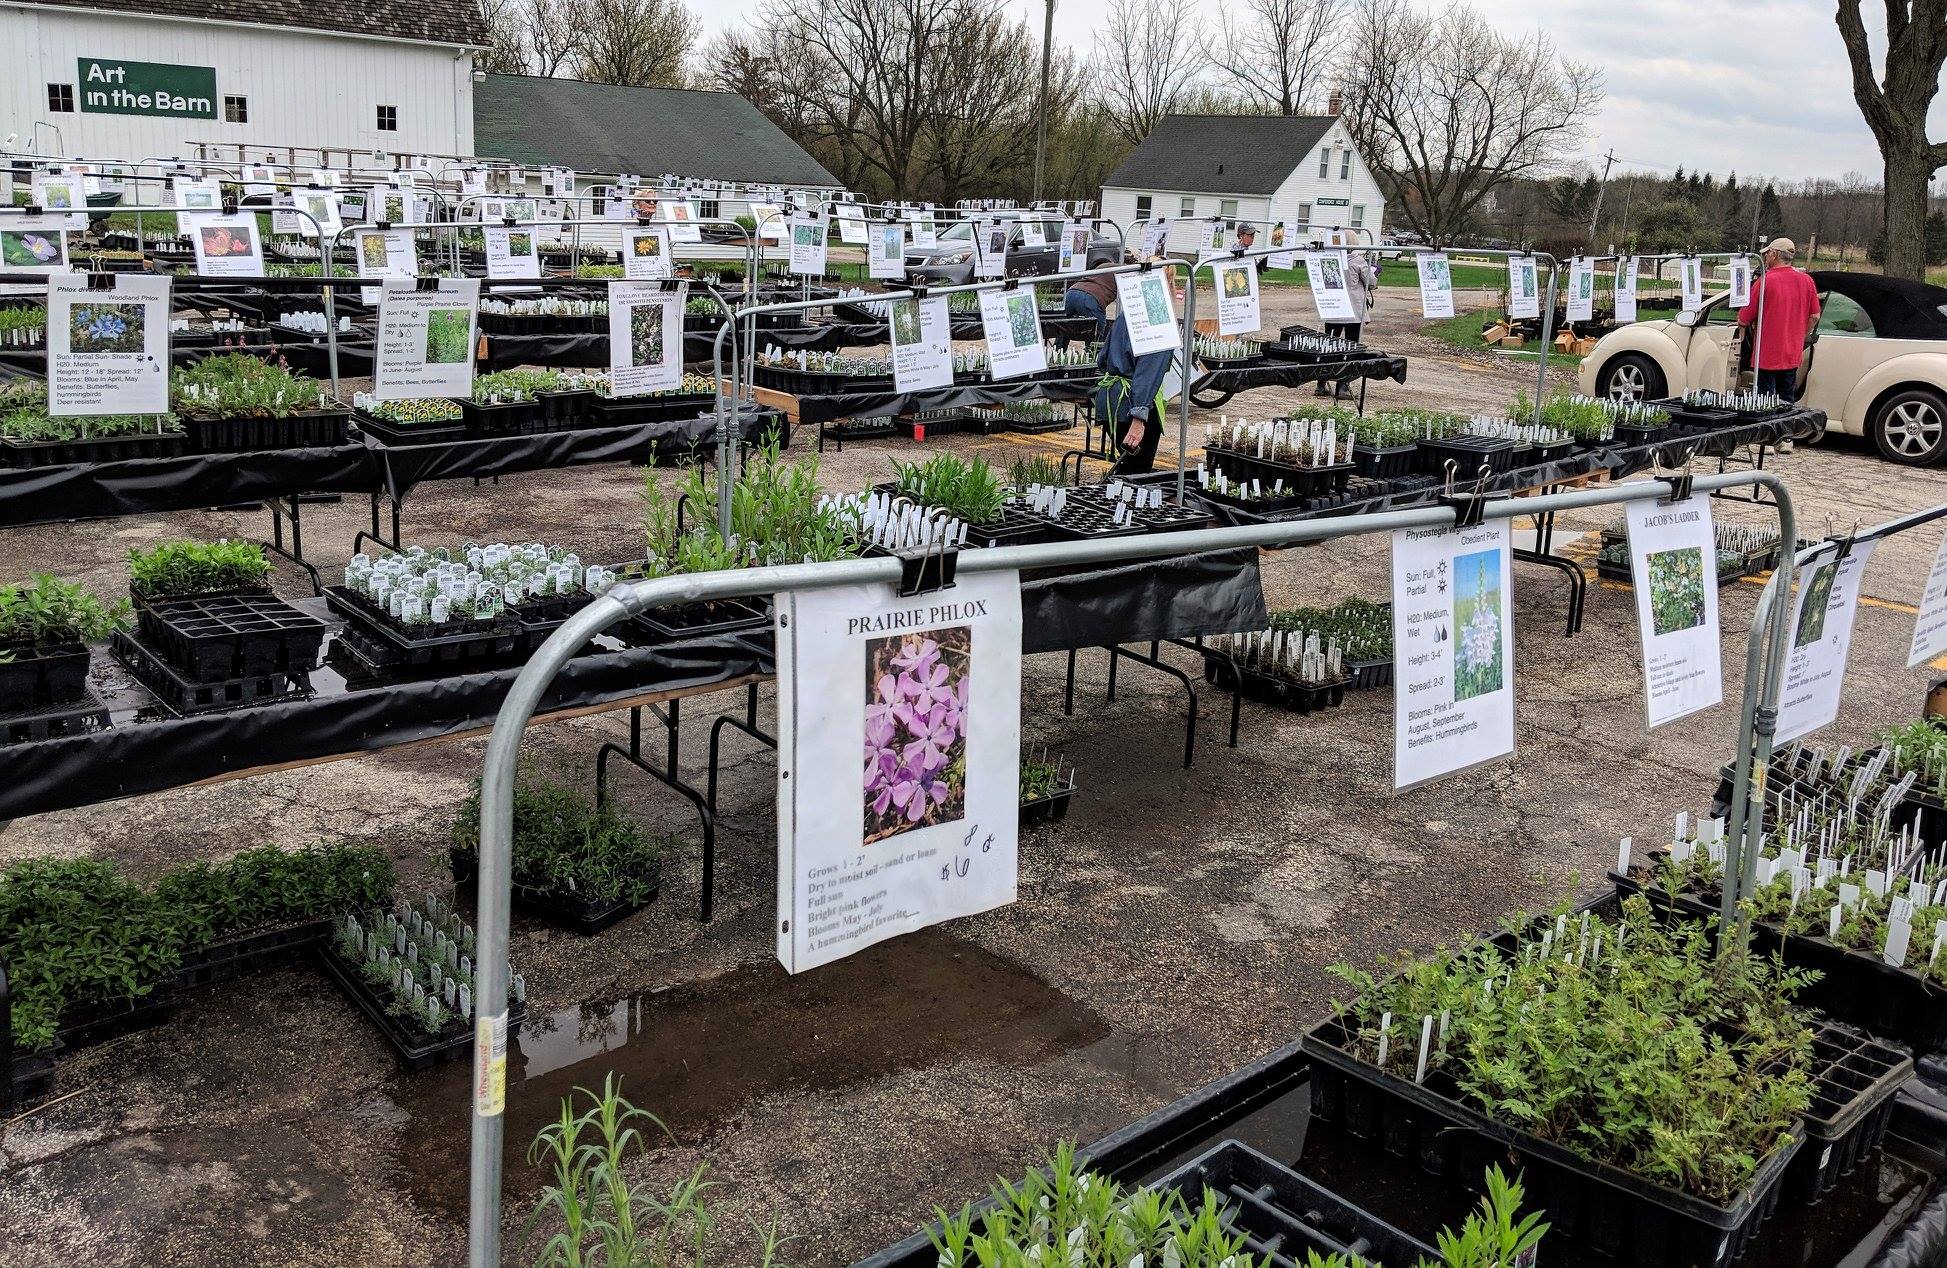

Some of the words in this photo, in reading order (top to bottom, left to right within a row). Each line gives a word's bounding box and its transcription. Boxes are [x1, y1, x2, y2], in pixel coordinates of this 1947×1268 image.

[87, 63, 126, 84] Art
[87, 91, 107, 106] in
[111, 89, 152, 109] the
[155, 91, 211, 112] Barn
[56, 368, 80, 376] Height:
[106, 368, 132, 376] Spread:
[1644, 513, 1674, 528] JACOB'S
[1674, 510, 1701, 524] LADDER
[1405, 526, 1448, 541] Physostegia
[1461, 534, 1486, 546] Obedient
[1486, 531, 1500, 541] Plant
[1406, 571, 1421, 583] Sun:
[1406, 584, 1427, 596] Partial
[847, 609, 924, 636] PRAIRIE
[929, 599, 988, 623] PHLOX
[1423, 609, 1449, 621] Medium,
[1407, 627, 1420, 638] Wet
[1408, 653, 1430, 666] Height:
[1408, 680, 1432, 694] Spread:
[1408, 709, 1433, 722] Blooms:
[1434, 704, 1447, 714] Pink
[1448, 701, 1455, 709] in
[1407, 722, 1432, 735] August,
[1432, 711, 1465, 728] September
[1408, 735, 1434, 749] Benefits:
[1435, 720, 1478, 741] Hummingbirds
[808, 882, 825, 894] Dry
[827, 879, 837, 888] to
[839, 871, 863, 884] moist
[865, 866, 879, 877] soil
[884, 854, 904, 868] sand
[905, 853, 915, 863] or
[917, 847, 938, 860] loam
[808, 864, 839, 880] Grows
[807, 893, 826, 909] Full
[828, 891, 844, 902] sun
[808, 906, 836, 923] Bright
[838, 899, 859, 916] pink
[861, 888, 888, 907] flowers
[808, 920, 840, 938] Blooms
[843, 913, 862, 926] May
[868, 904, 884, 918] July
[807, 942, 815, 953] A
[817, 919, 875, 949] hummingbird
[875, 908, 907, 927] favorite
